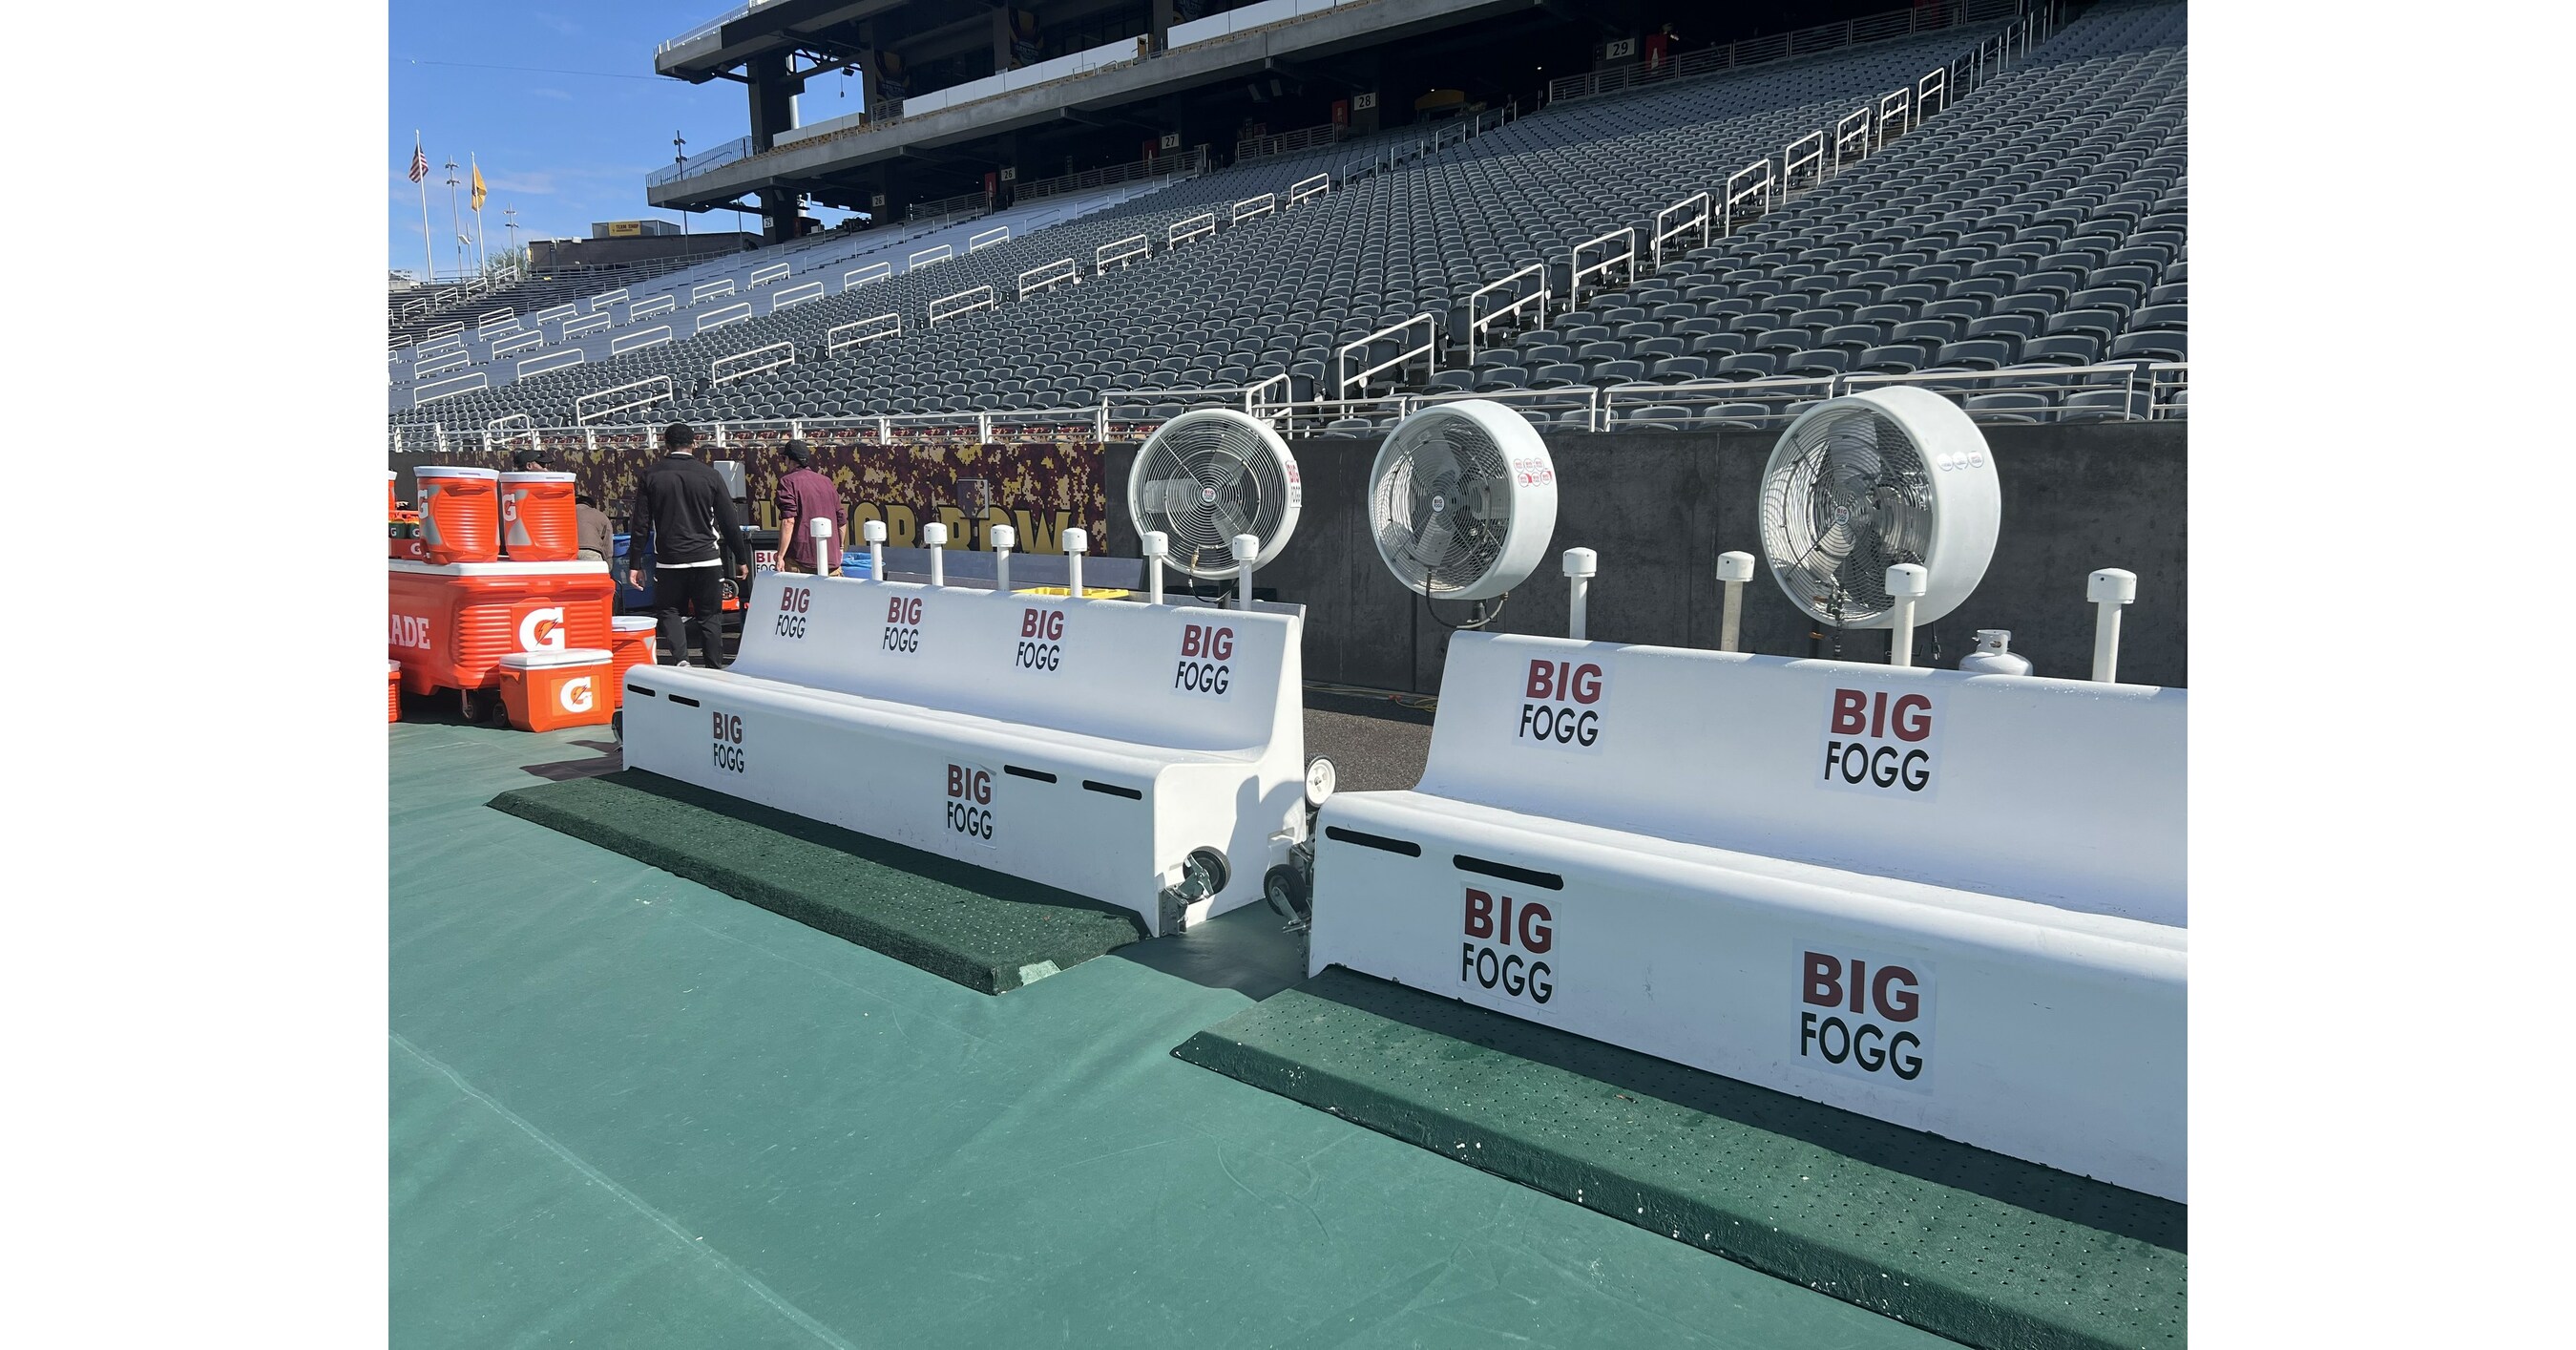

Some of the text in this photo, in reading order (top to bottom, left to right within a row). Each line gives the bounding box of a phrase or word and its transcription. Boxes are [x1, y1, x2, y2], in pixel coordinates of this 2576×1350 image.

[1613, 42, 1628, 56] 29
[1359, 96, 1372, 108] 28
[1165, 137, 1175, 147] 27
[1005, 170, 1013, 179] 26
[503, 494, 516, 521] G
[781, 587, 810, 613] BIG
[887, 597, 922, 625] BIG
[388, 614, 430, 649] ADE
[519, 607, 565, 651] G
[775, 614, 806, 639] FOGG
[882, 626, 919, 653] FOGG
[1021, 608, 1064, 641] BIG
[1016, 642, 1060, 671] FOGG
[1182, 624, 1233, 661] BIG
[560, 676, 593, 713] G
[1175, 661, 1229, 695] FOGG
[1525, 659, 1602, 705] BIG
[713, 711, 742, 744] BIG
[1519, 704, 1599, 747] FOGG
[1831, 688, 1932, 742] BIG
[713, 743, 744, 773] FOGG
[1824, 741, 1930, 791] FOGG
[948, 764, 991, 805] BIG
[947, 801, 993, 840] FOGG
[1464, 887, 1552, 954] BIG
[1462, 942, 1553, 1003] FOGG
[1803, 951, 1919, 1023] BIG
[1801, 1011, 1923, 1080] FOGG
